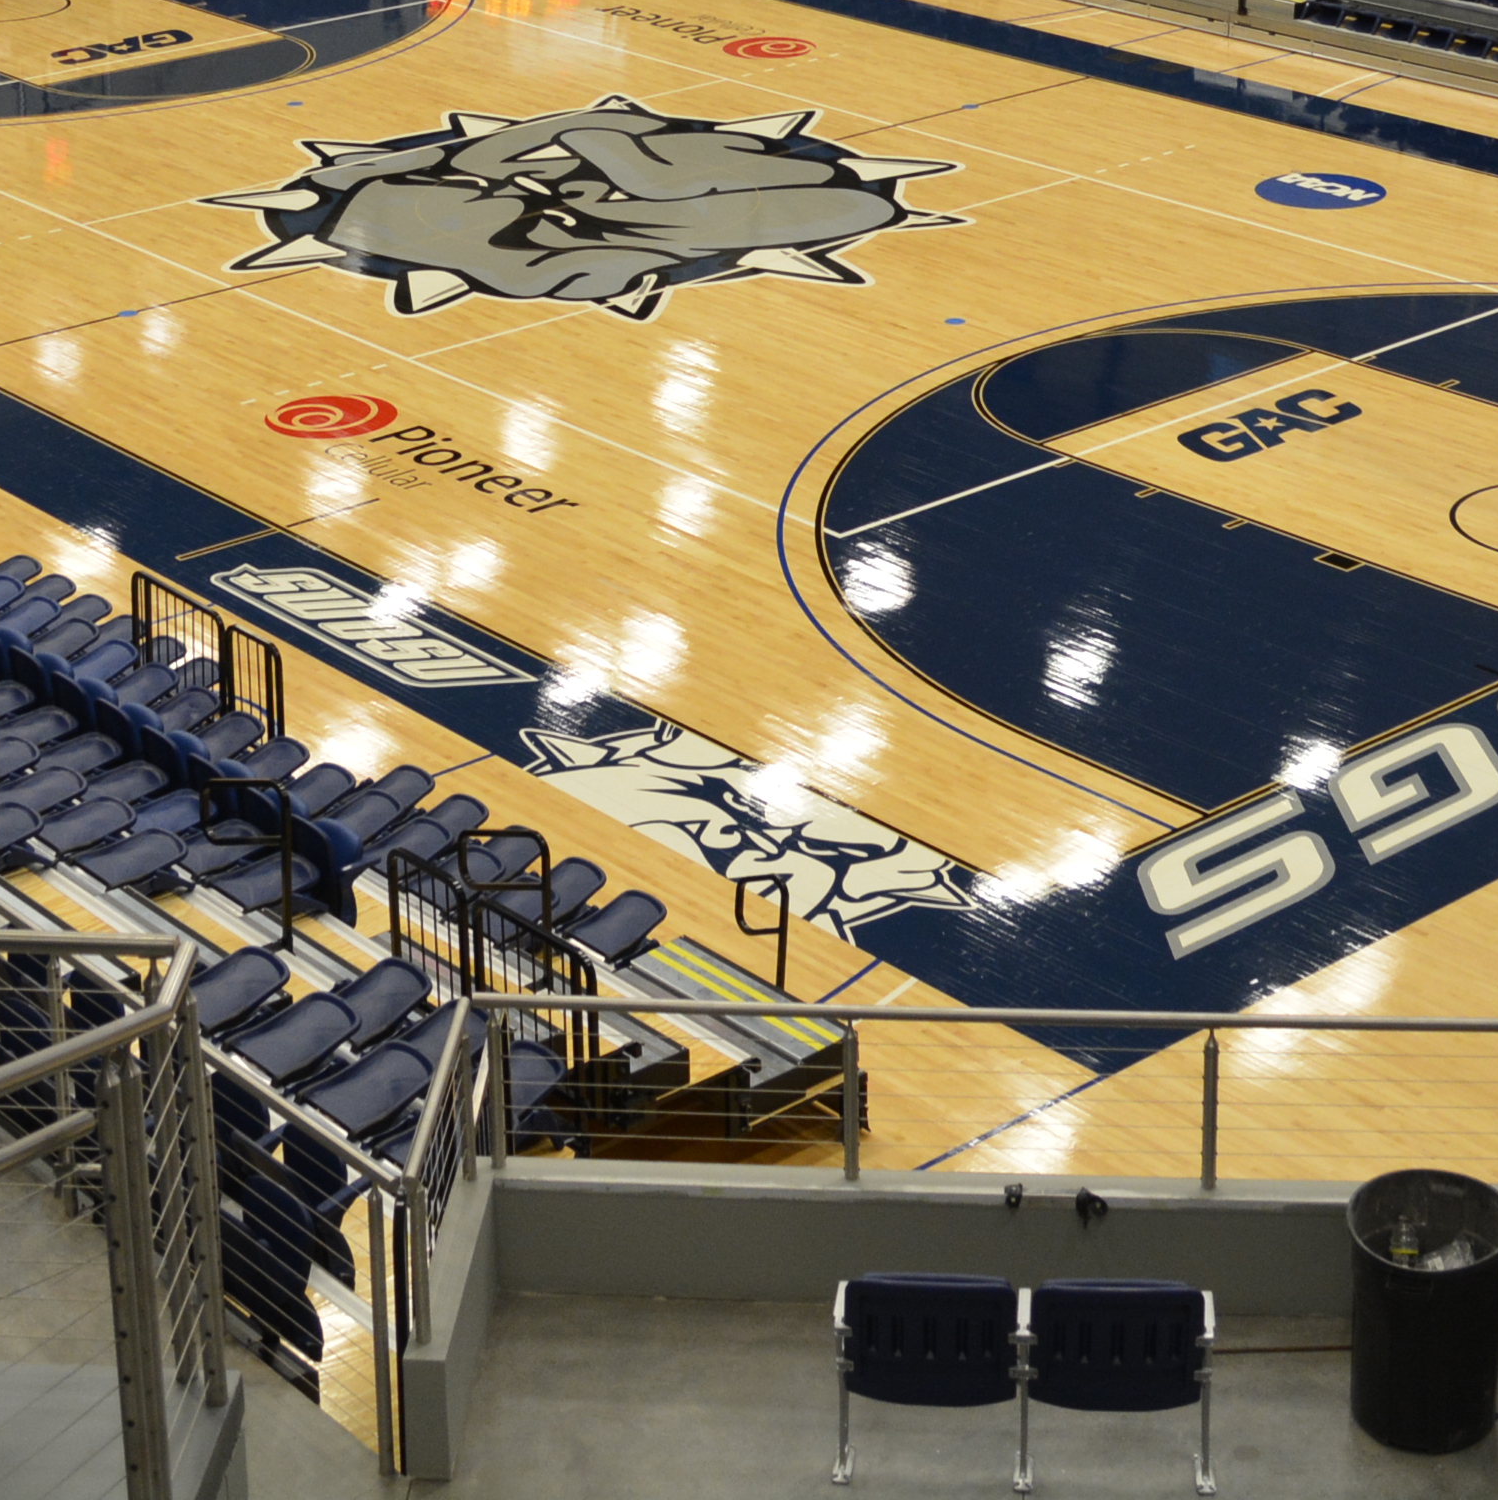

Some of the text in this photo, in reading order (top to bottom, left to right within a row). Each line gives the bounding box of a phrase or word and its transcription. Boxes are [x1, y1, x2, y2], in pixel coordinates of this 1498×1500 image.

[51, 29, 194, 66] GAC
[594, 5, 737, 44] Pioneer
[1276, 173, 1380, 201] NCAA
[1177, 389, 1362, 462] GAC
[325, 443, 433, 490] Cellular
[368, 425, 580, 514] Pioneer
[228, 571, 508, 681] SWOSU
